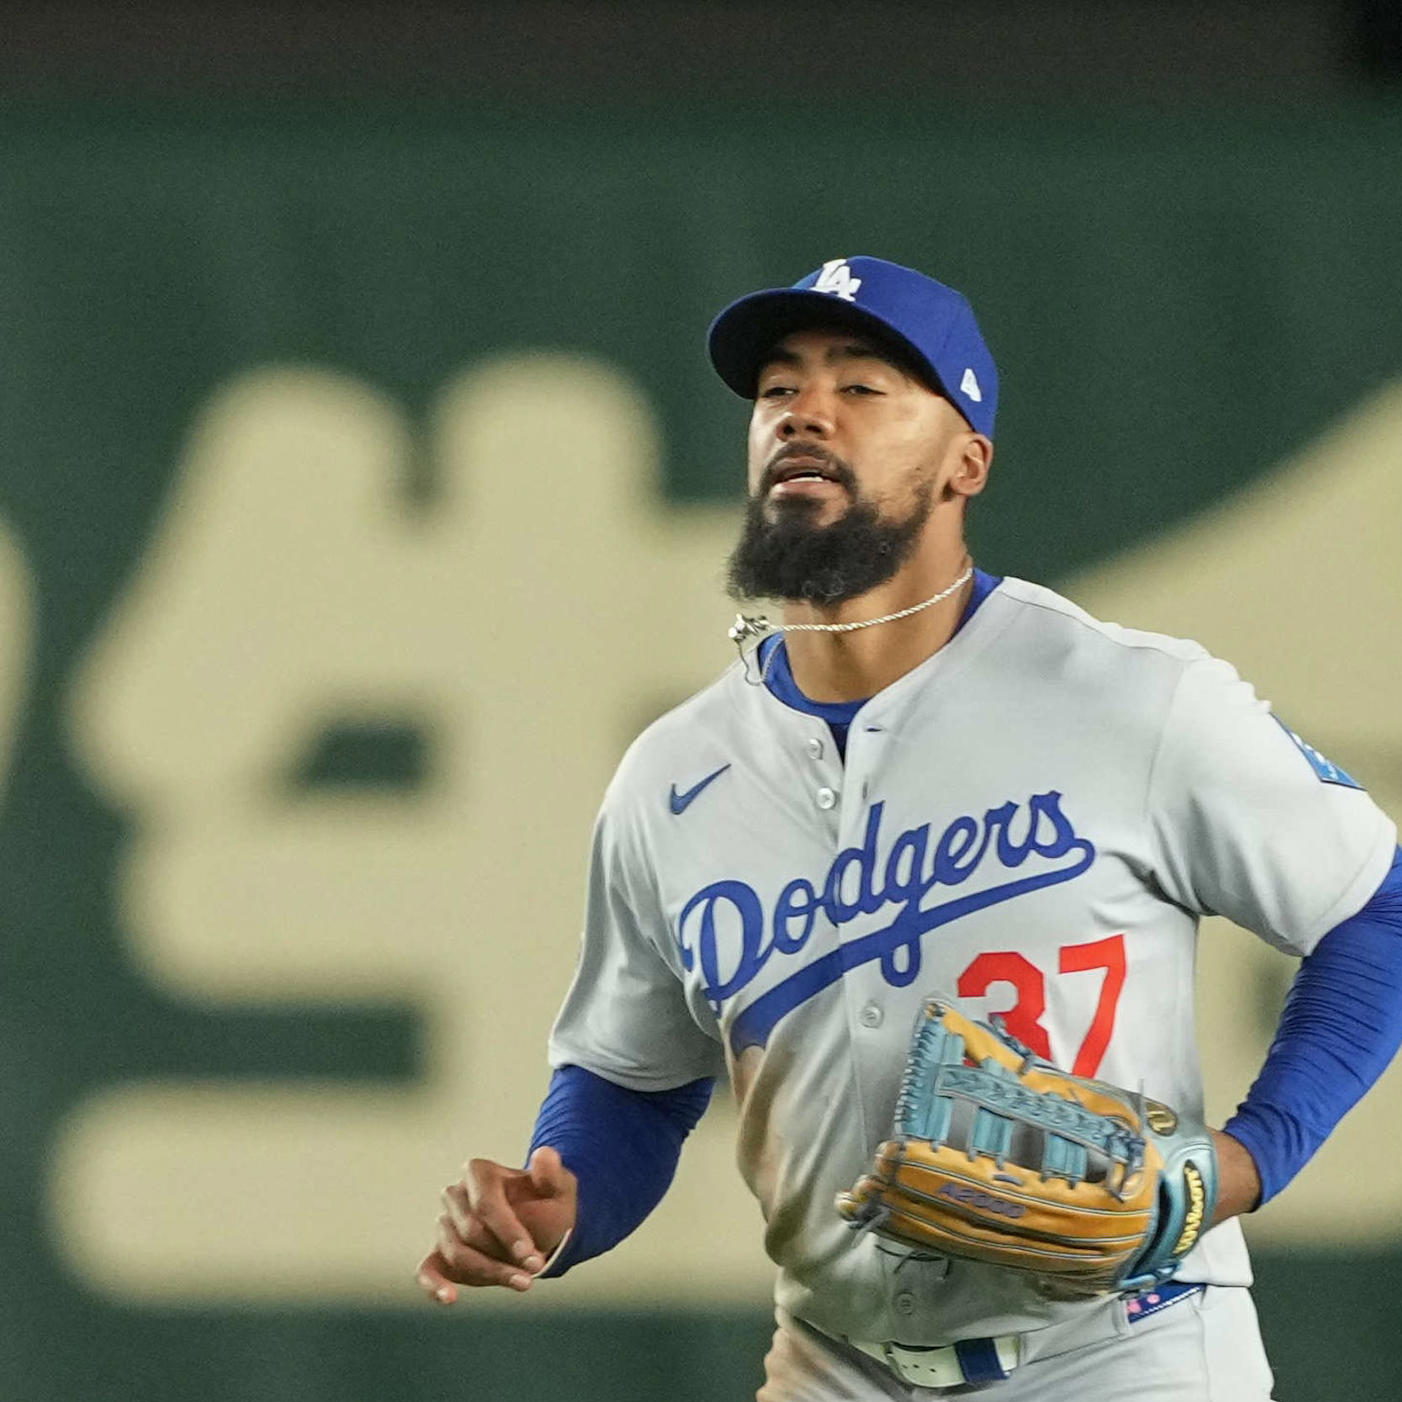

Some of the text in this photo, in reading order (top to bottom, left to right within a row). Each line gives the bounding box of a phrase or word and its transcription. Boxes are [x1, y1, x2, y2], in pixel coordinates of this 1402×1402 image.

[810, 258, 861, 302] LA
[679, 790, 1095, 1018] Dodgers
[956, 933, 1126, 1080] 37
